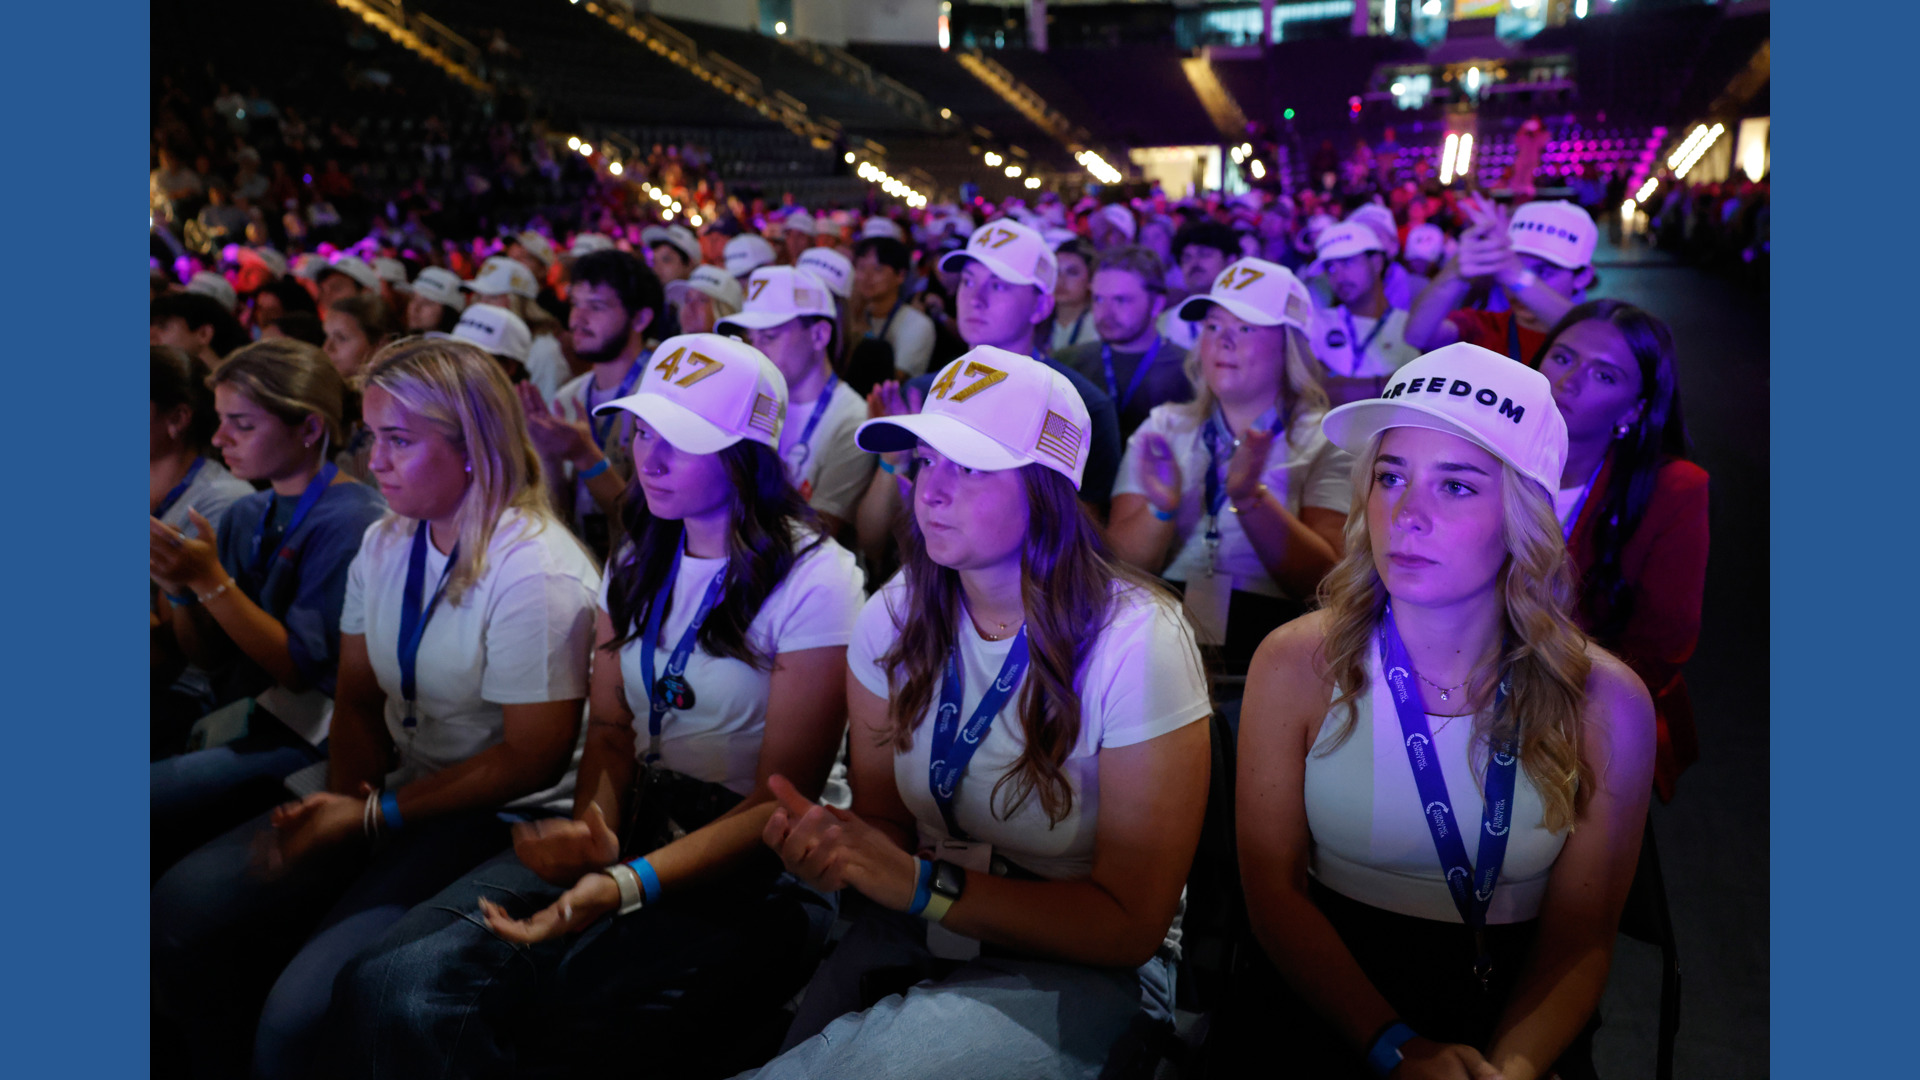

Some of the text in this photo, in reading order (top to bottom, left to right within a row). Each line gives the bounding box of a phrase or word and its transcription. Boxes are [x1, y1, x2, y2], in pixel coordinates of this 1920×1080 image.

[976, 227, 1019, 249] 47
[1218, 267, 1265, 290] 47
[654, 346, 725, 388] 47
[930, 359, 1009, 403] 47
